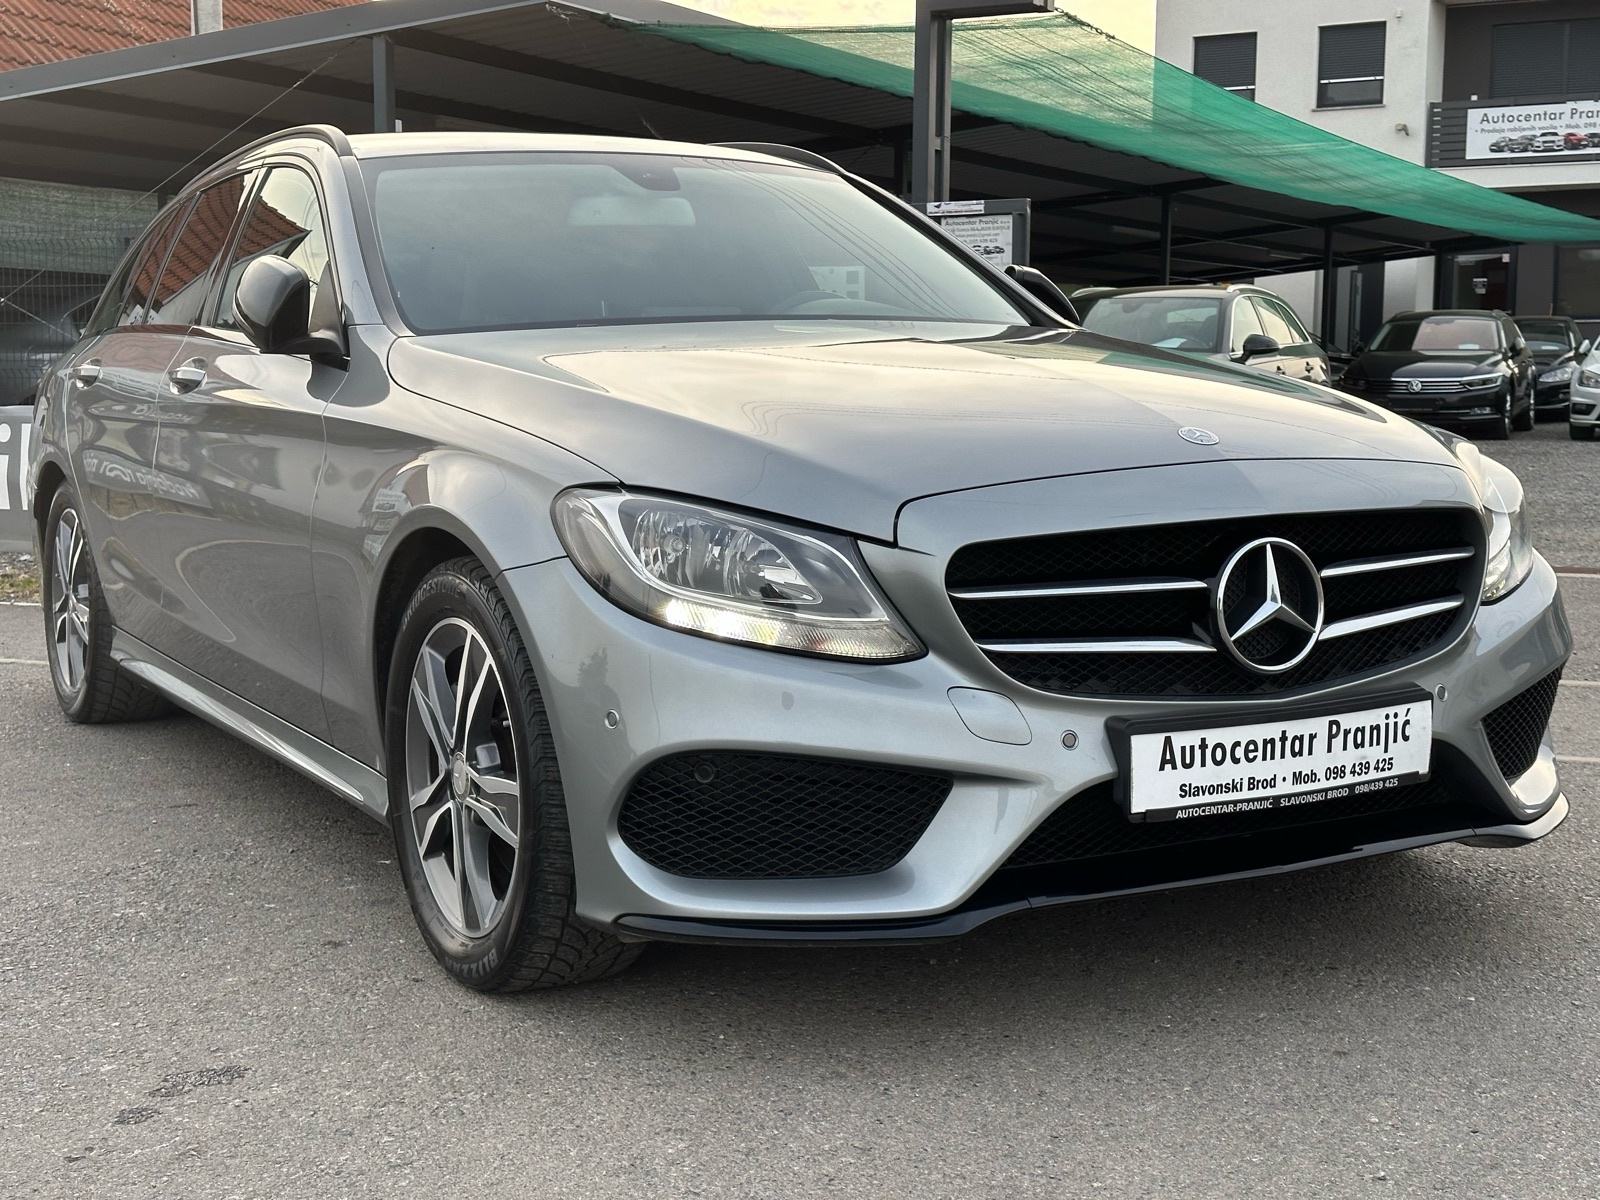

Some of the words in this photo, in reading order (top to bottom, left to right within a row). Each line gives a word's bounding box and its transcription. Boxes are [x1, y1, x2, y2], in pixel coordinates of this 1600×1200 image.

[1480, 111, 1565, 124] Autocentar
[1158, 729, 1318, 772] Autocentar
[1327, 707, 1412, 754] Pranjić
[1175, 796, 1274, 820] AUTOCENTAR-PRANJIĆ
[1279, 792, 1326, 807] SLAVONSKI
[1326, 787, 1349, 800] BROD
[1354, 780, 1384, 795] 098/439
[1384, 777, 1399, 789] 425
[1178, 777, 1244, 799] Slavonski
[1247, 773, 1277, 791] Brod
[1291, 769, 1321, 787] Mob.
[1324, 765, 1346, 782] 098
[1349, 761, 1371, 778] 439
[1373, 757, 1394, 774] 425
